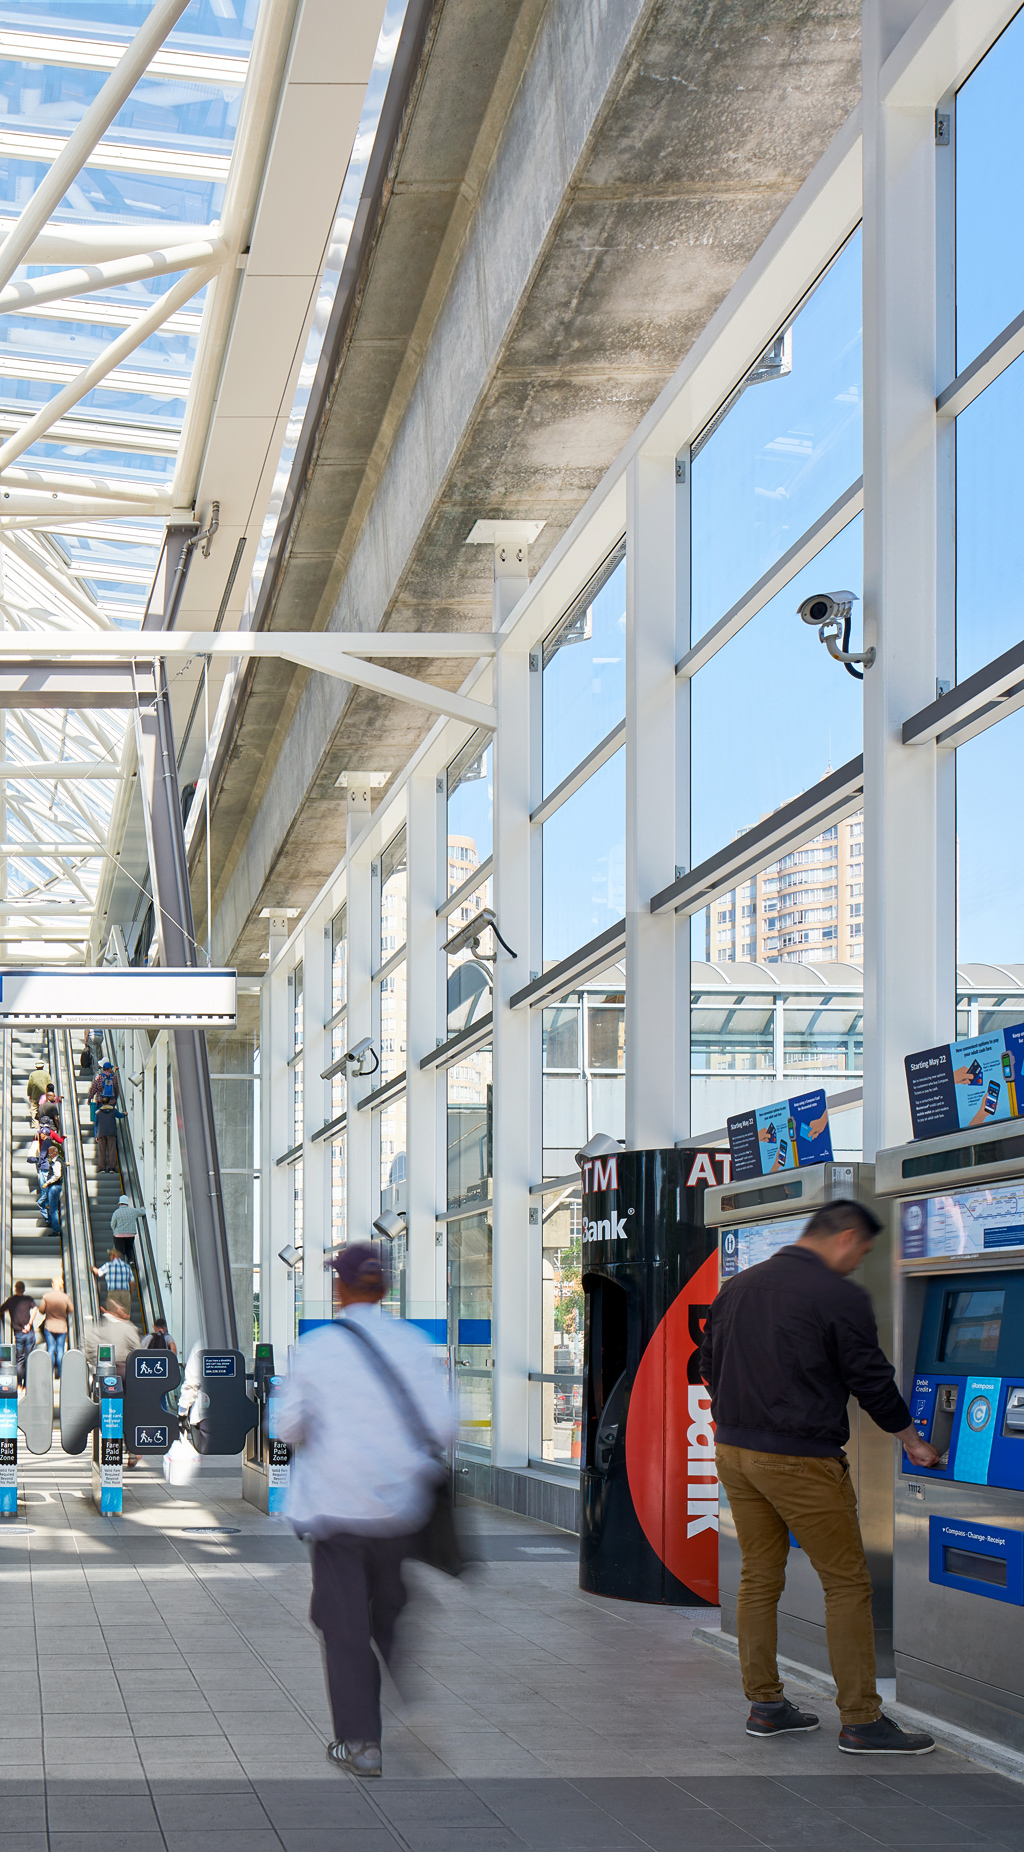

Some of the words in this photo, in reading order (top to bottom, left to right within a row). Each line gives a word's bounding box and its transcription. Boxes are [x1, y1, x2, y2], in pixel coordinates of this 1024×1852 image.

[962, 1044, 977, 1052] convenient
[978, 1041, 989, 1049] options
[910, 1059, 929, 1071] Starting
[929, 1057, 940, 1067] May
[940, 1055, 946, 1064] 22
[730, 1120, 743, 1131] Starting
[582, 1156, 619, 1195] TM
[686, 1152, 732, 1188] AT
